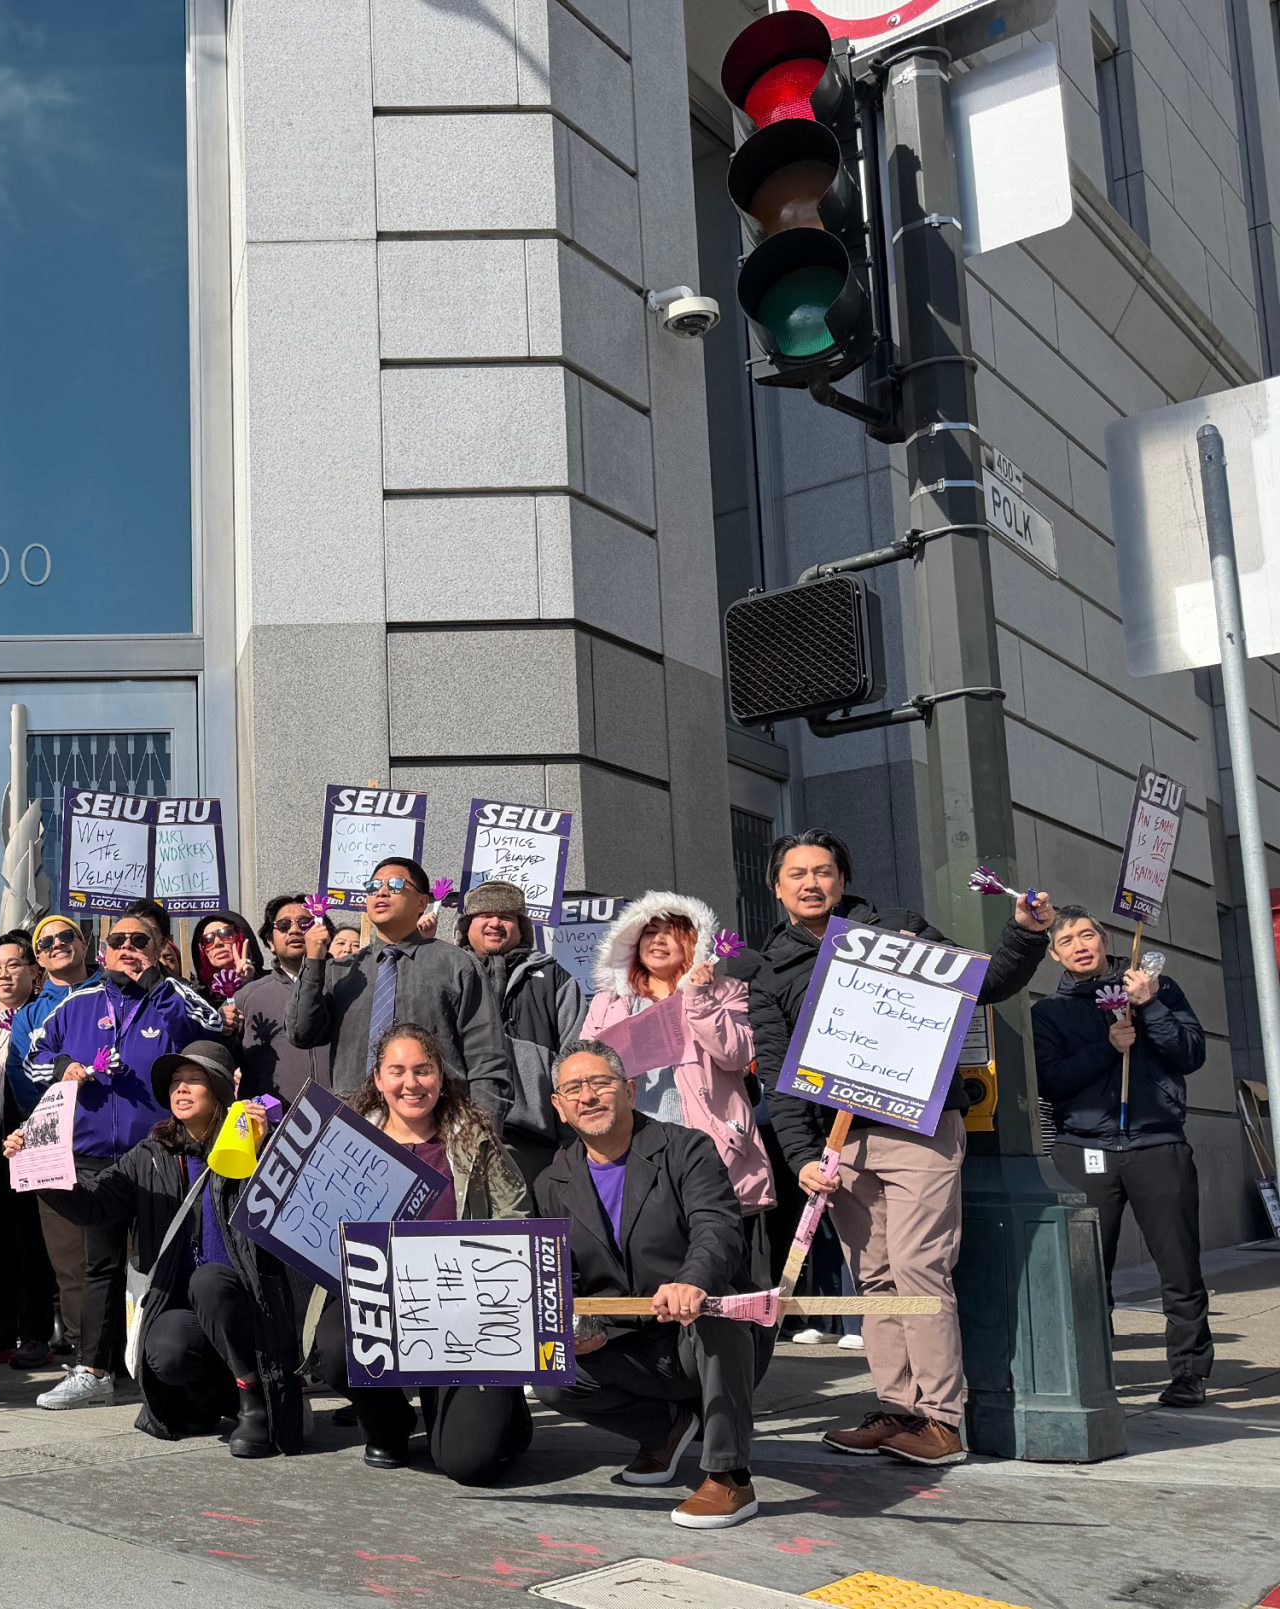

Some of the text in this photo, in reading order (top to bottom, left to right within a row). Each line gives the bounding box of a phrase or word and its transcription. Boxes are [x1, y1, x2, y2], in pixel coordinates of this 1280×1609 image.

[997, 454, 1014, 482] 400
[991, 485, 1033, 546] POLK
[72, 791, 148, 821] SEIU
[334, 789, 417, 816] SEIU
[1140, 771, 1183, 812] SEIU
[157, 800, 211, 823] EIU
[335, 816, 382, 836] Court
[478, 803, 562, 832] SEIU
[76, 820, 115, 846] WHY
[478, 827, 537, 849] JUSTICE
[89, 843, 123, 862] THE
[353, 854, 378, 867] for
[494, 848, 546, 868] DELAYED
[334, 869, 370, 886] Just
[90, 898, 122, 909] LOCAL
[167, 901, 220, 910] LOCAL 1021
[527, 909, 551, 919] 1021
[561, 898, 615, 923] EIU
[547, 928, 597, 944] When
[835, 928, 973, 984] SEIU
[837, 967, 916, 1008] Justice
[832, 1004, 846, 1018] is
[872, 1000, 952, 1033] Delayed
[817, 1017, 880, 1051] Justice
[846, 1053, 915, 1084] Denied
[791, 1080, 822, 1095] SEIU
[829, 1084, 882, 1108] LOCAL
[886, 1101, 924, 1119] 1021
[246, 1095, 322, 1230] SEIU
[280, 1125, 341, 1233] STAFF
[302, 1140, 372, 1249] UP THE
[407, 1181, 431, 1216] 1021
[541, 1235, 559, 1334] LOCAL 1021
[346, 1239, 394, 1371] SEIU
[395, 1264, 439, 1361] STAFF
[434, 1253, 477, 1364] UP THE
[555, 1341, 566, 1372] SEIU
